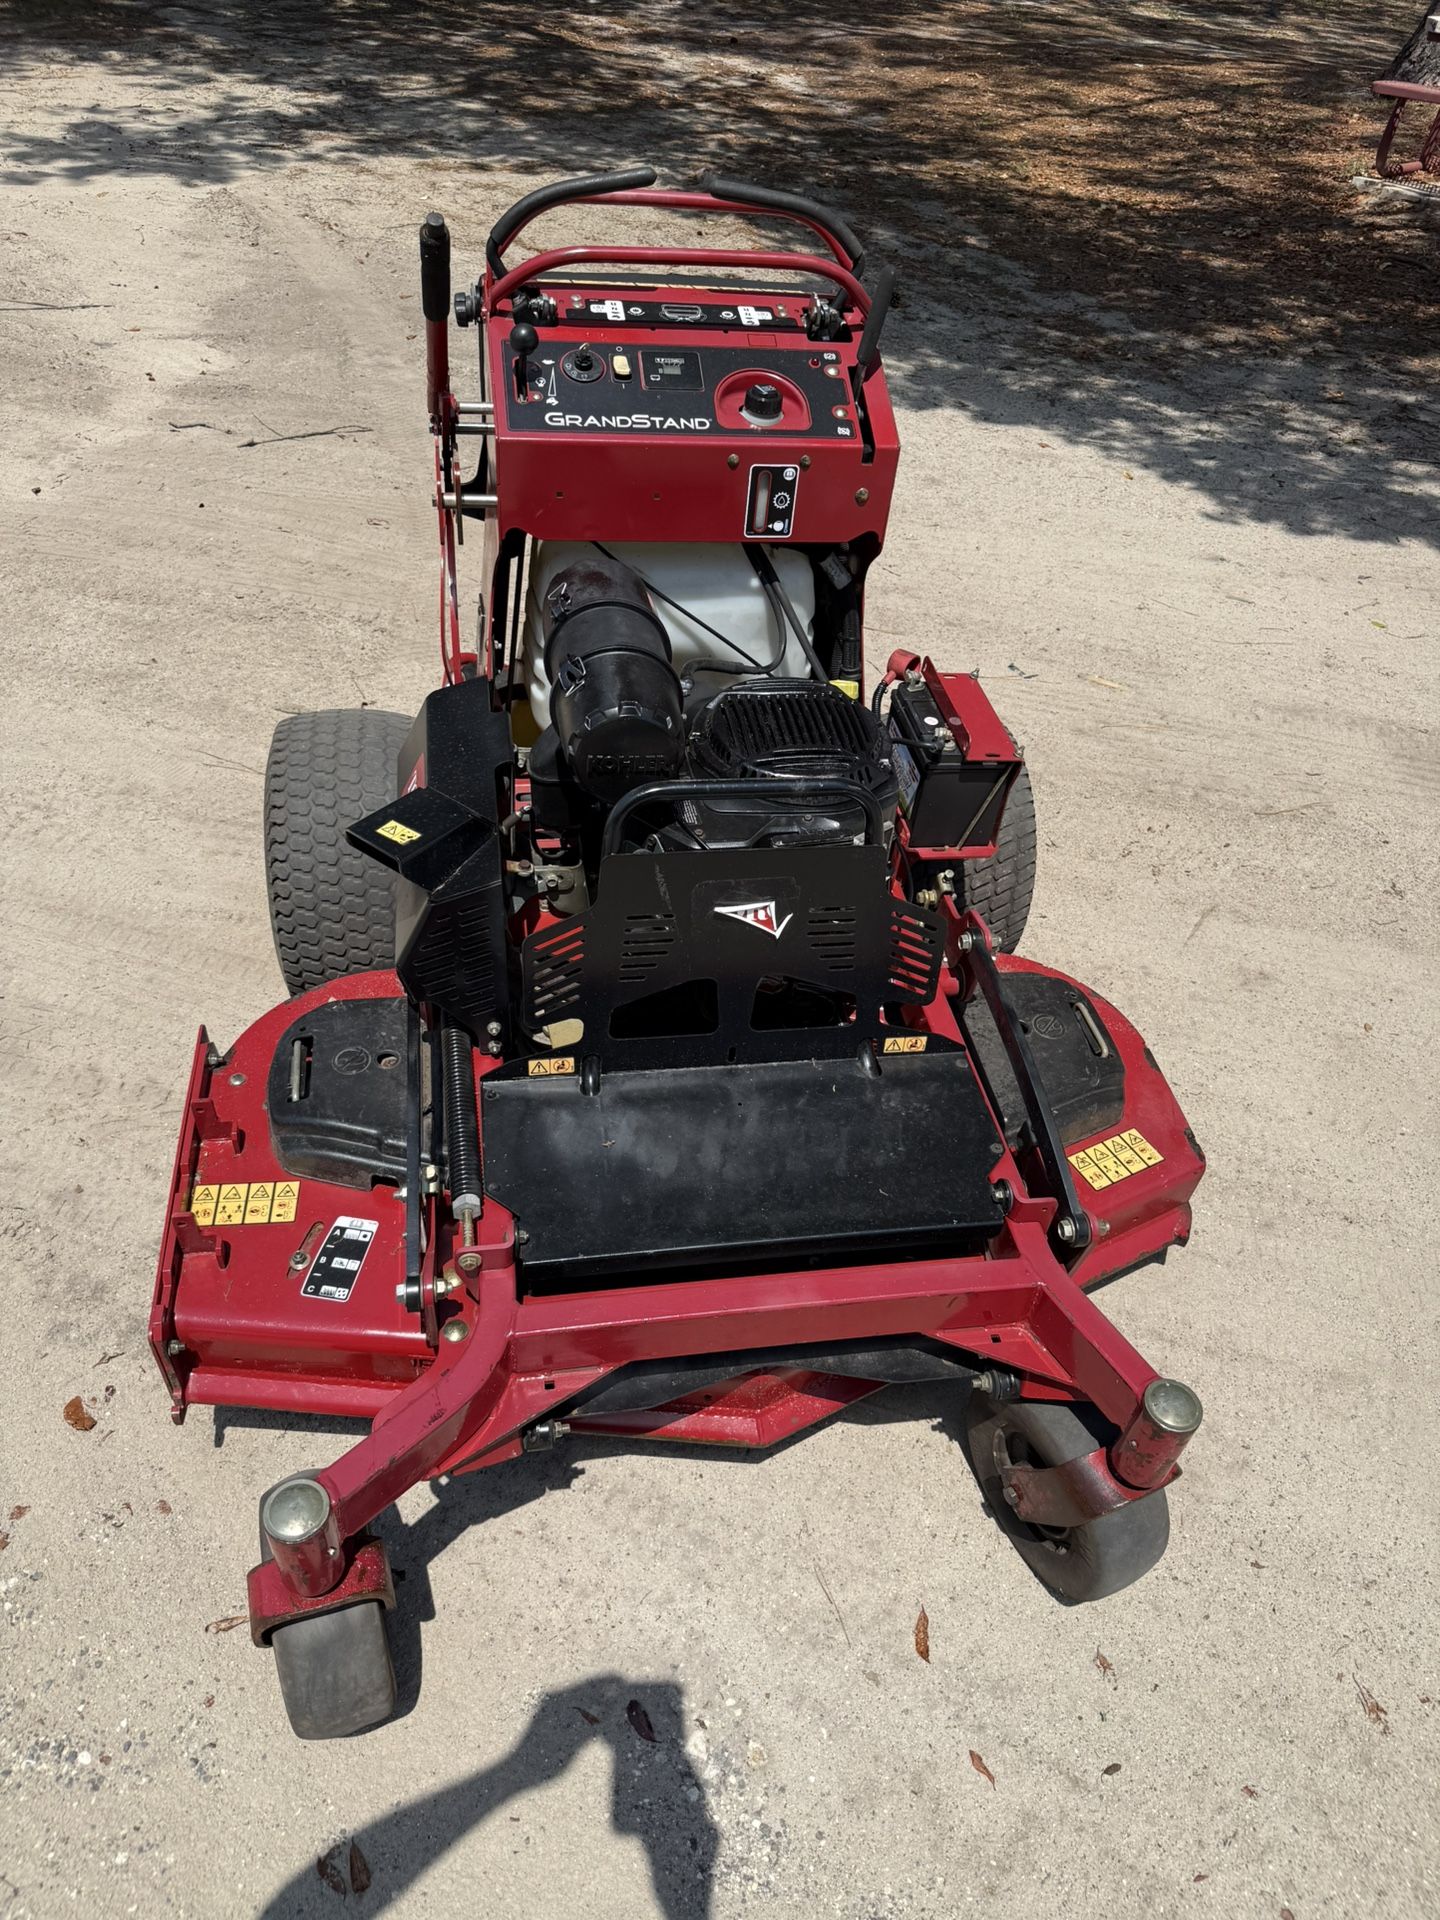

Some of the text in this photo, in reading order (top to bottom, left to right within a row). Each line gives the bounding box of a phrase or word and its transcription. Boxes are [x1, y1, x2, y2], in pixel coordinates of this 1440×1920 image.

[544, 411, 711, 430] GRANDSTAND
[586, 753, 667, 775] KOHLER
[333, 1228, 341, 1236] A
[319, 1256, 327, 1264] B
[307, 1285, 316, 1293] C
